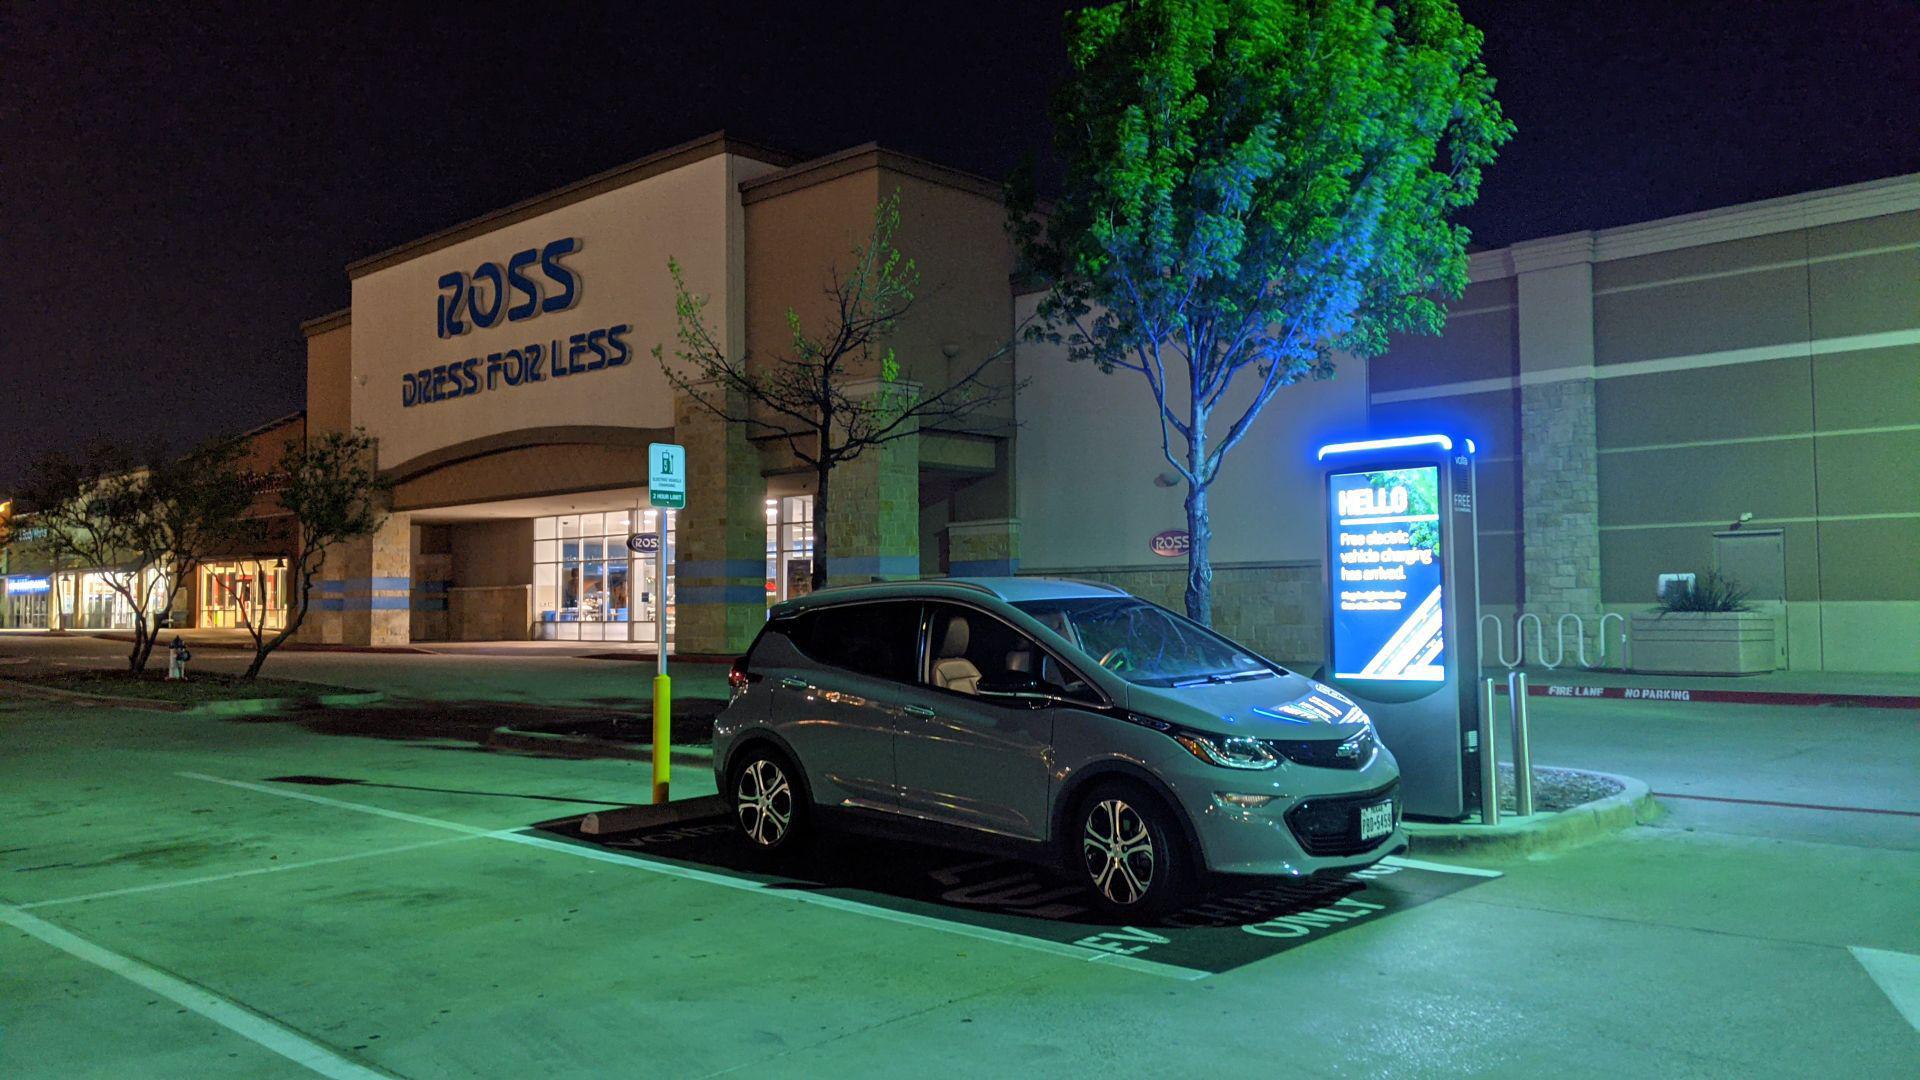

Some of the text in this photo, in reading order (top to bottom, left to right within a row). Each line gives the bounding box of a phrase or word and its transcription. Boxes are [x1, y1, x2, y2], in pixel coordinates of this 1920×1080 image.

[437, 237, 582, 339] ROSS
[402, 324, 633, 408] DRESS FOR LESS
[1338, 486, 1408, 516] HELLO
[1454, 494, 1471, 507] FREE
[1155, 535, 1190, 551] ROSS
[1340, 529, 1409, 546] Free electric
[1340, 547, 1433, 565] vehicle charging
[1548, 686, 1573, 696] FIRE
[1624, 688, 1640, 698] NO
[1642, 689, 1690, 701] PARKING
[1240, 898, 1387, 938] ONLY
[1073, 926, 1171, 955] EV
